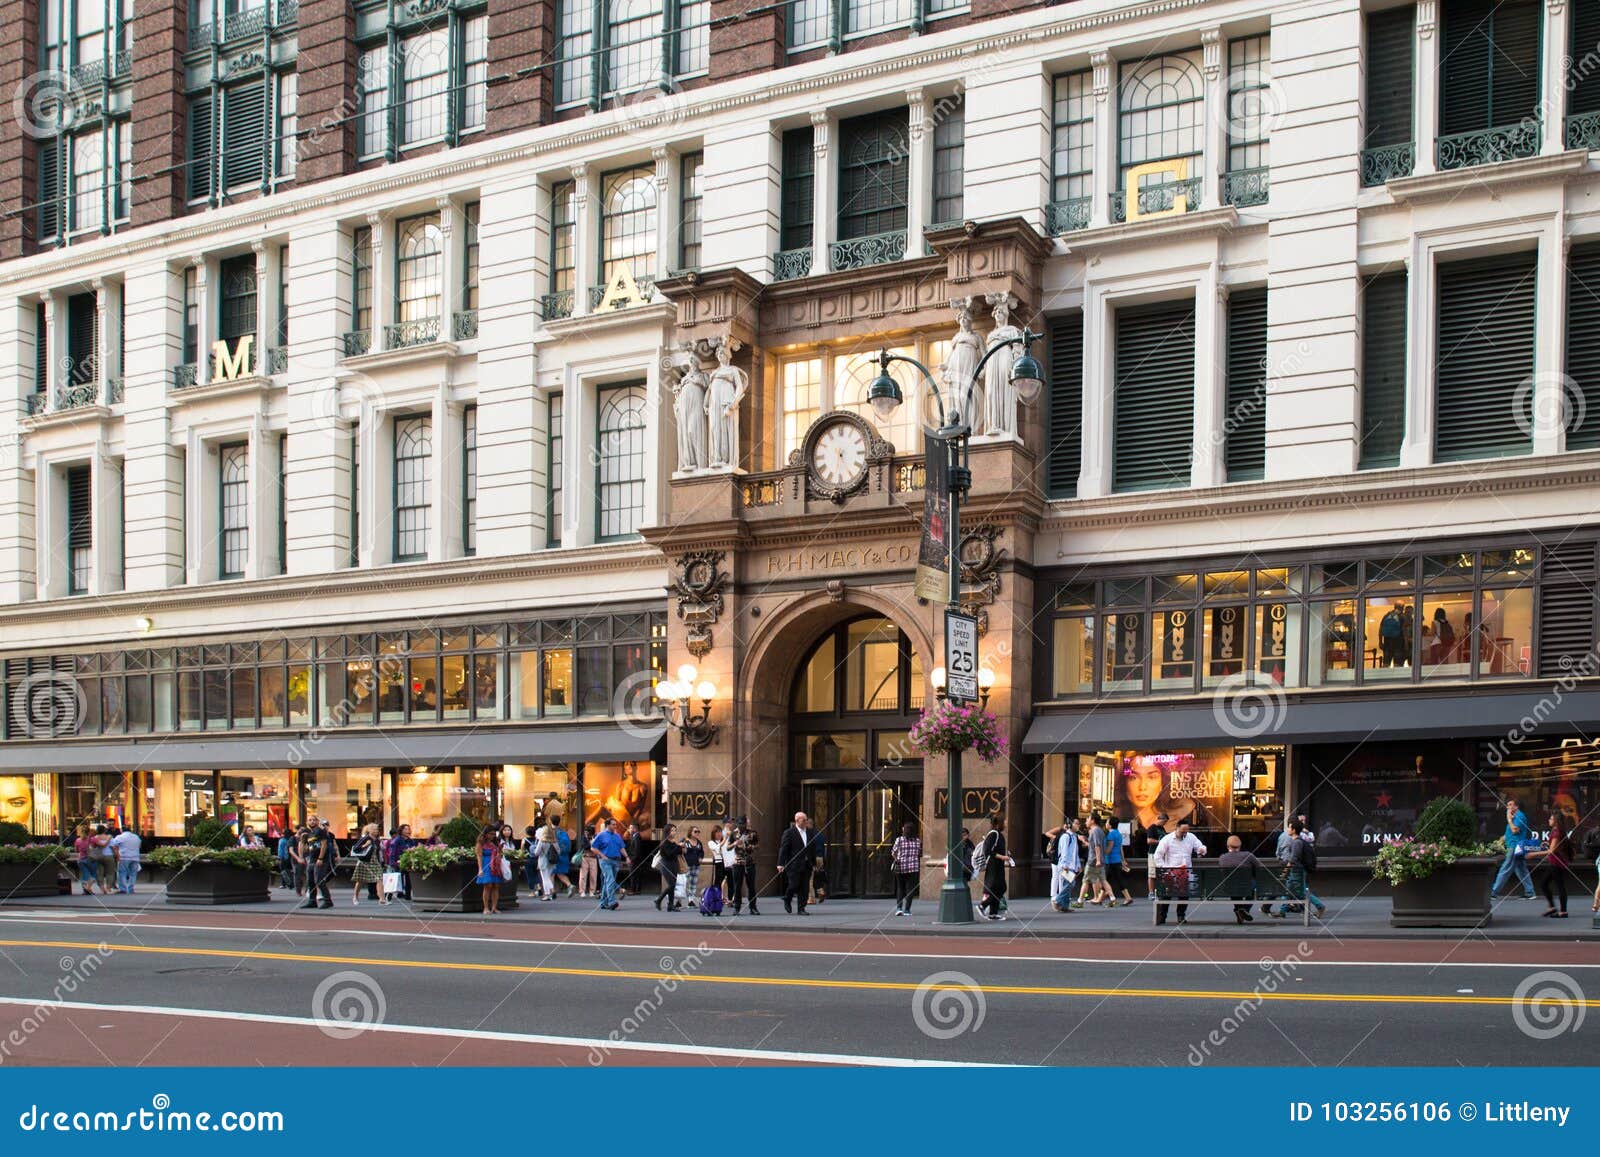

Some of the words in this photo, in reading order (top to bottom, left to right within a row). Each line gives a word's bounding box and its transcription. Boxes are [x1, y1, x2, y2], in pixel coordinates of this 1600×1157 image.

[1126, 157, 1187, 224] C
[593, 261, 644, 313] A
[211, 334, 254, 384] M
[955, 621, 967, 630] CITY
[953, 629, 970, 640] SPEED
[954, 639, 968, 649] LIMIT
[951, 650, 973, 673] 25
[1170, 770, 1226, 783] INSTANT
[1170, 782, 1192, 791] FULL
[1193, 781, 1226, 791] COVER
[1170, 789, 1226, 799] CONCEALER
[938, 790, 1001, 814] MCY'S
[1363, 833, 1402, 844] DKNY
[1531, 831, 1574, 841] DKY
